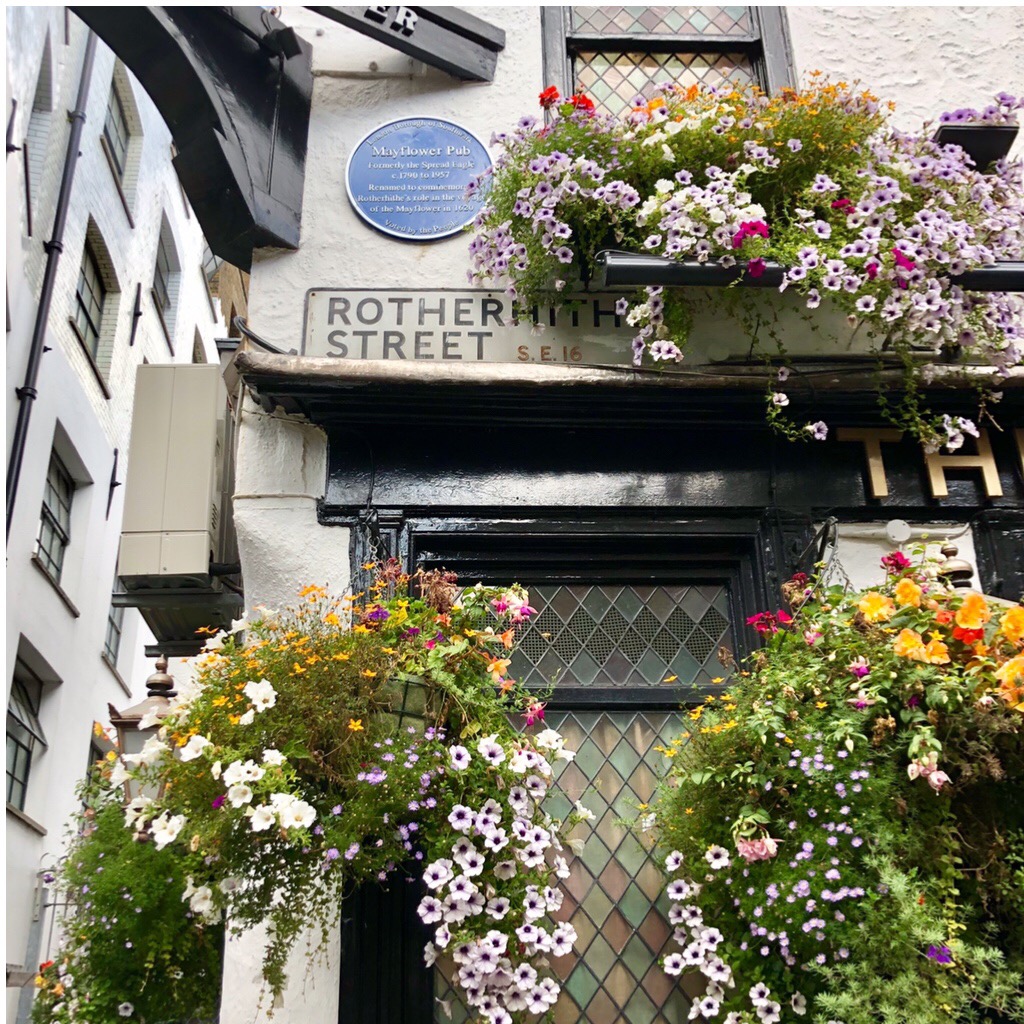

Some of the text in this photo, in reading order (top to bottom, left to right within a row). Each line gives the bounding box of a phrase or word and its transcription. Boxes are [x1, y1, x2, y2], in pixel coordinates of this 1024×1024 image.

[372, 145, 471, 159] Mayflower Pub
[368, 162, 405, 170] Formerly
[421, 161, 450, 170] Spread
[431, 171, 450, 179] 1957
[432, 194, 441, 202] in
[396, 205, 442, 214] Mayflower
[327, 297, 641, 328] ROTHERHITH
[326, 330, 494, 360] STREET
[836, 426, 1024, 497] TH
